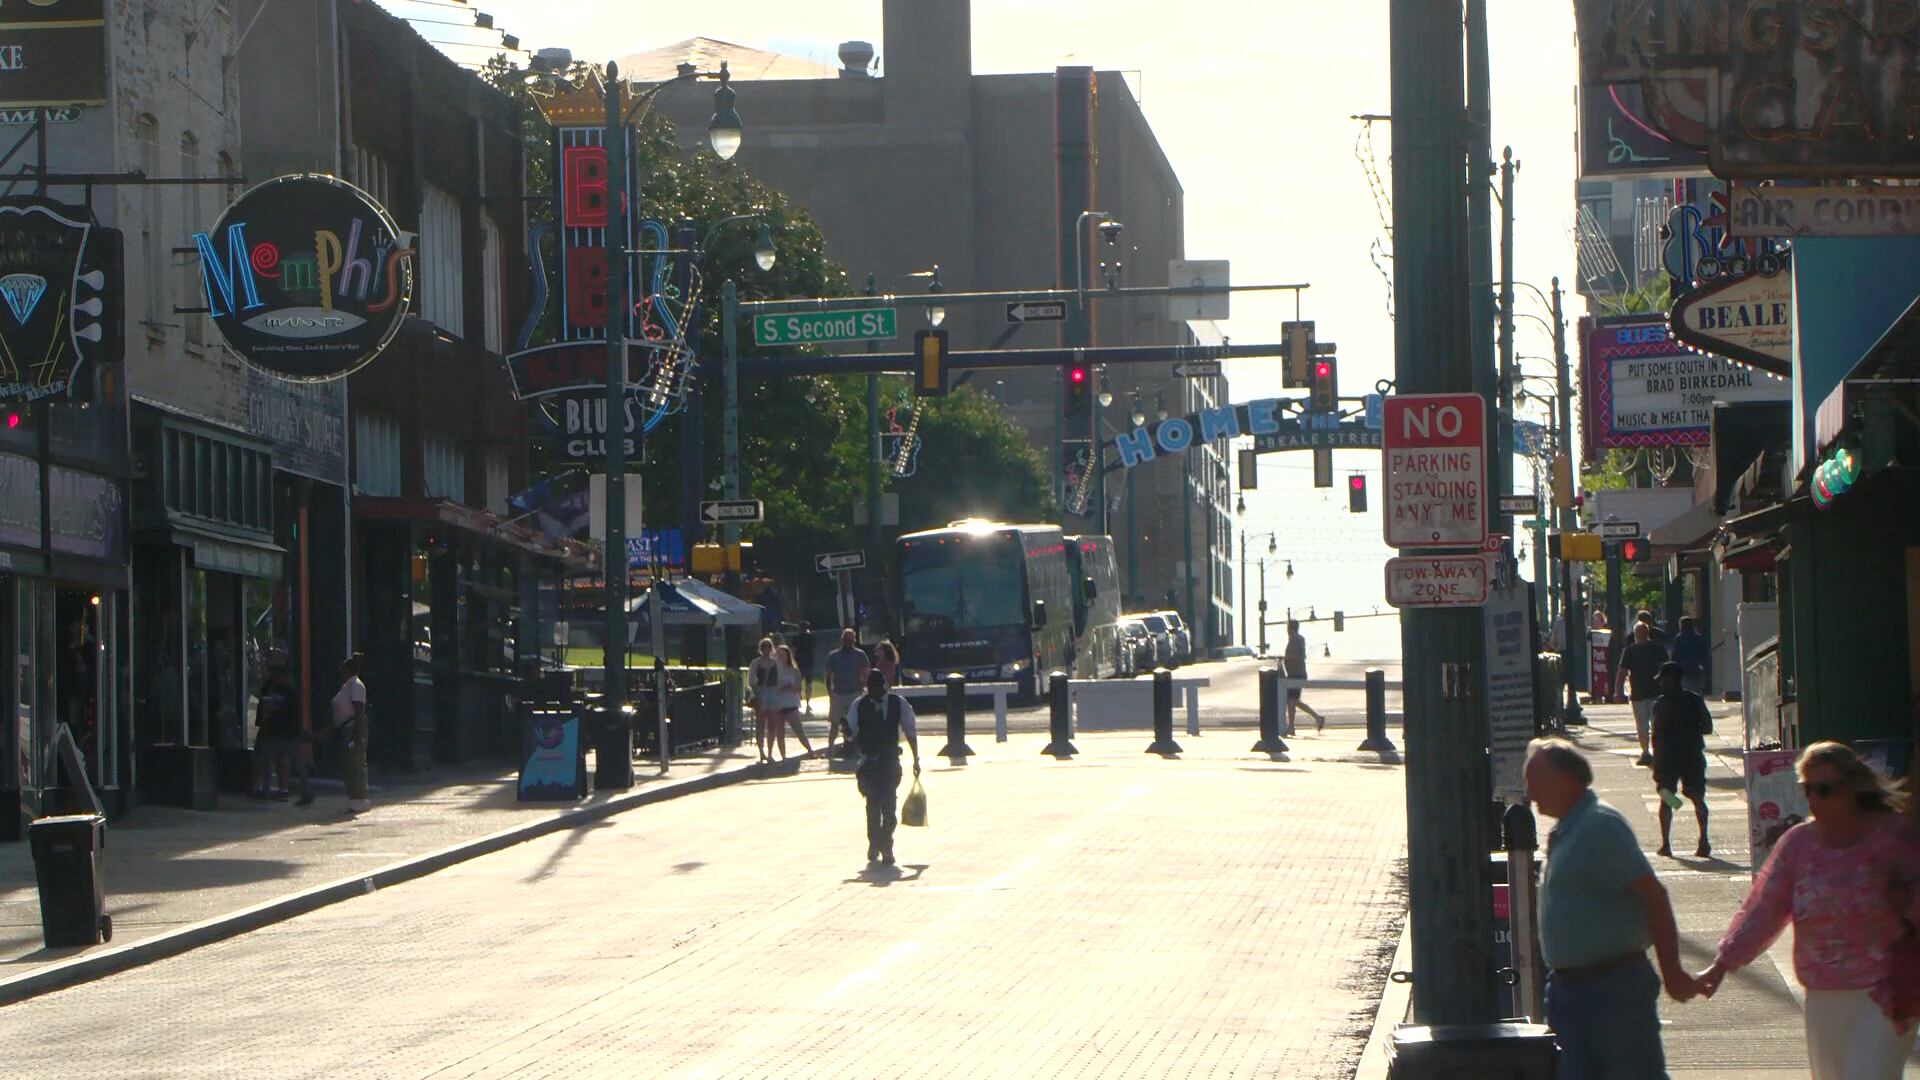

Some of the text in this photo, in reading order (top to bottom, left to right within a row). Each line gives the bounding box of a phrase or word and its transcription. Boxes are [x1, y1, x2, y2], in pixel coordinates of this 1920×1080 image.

[192, 217, 416, 319] Memphis
[1043, 305, 1060, 316] WAY
[1698, 303, 1787, 329] BEALE
[764, 313, 889, 341] S. Second St.
[1616, 326, 1666, 345] BLUES
[1629, 364, 1645, 377] PUT
[1648, 363, 1672, 376] SOME
[1675, 360, 1704, 375] SOUTH
[1708, 359, 1717, 372] IN
[1647, 374, 1752, 393] BRAD BIRKEDAHL
[566, 397, 635, 434] BLUS
[1403, 405, 1463, 439] NO
[1617, 412, 1648, 427] MUSIC
[1662, 410, 1687, 424] MEAT
[1691, 409, 1710, 422] THA
[1115, 399, 1279, 468] HOME
[1267, 432, 1381, 448] BEALE STREE
[1393, 453, 1470, 473] PARKING
[1393, 481, 1477, 500] STANDING
[736, 504, 755, 516] WAY
[1394, 503, 1477, 521] ANYME
[1620, 526, 1634, 534] WAY
[1395, 567, 1479, 580] TOW-AWAY
[1415, 583, 1460, 597] ZONE
